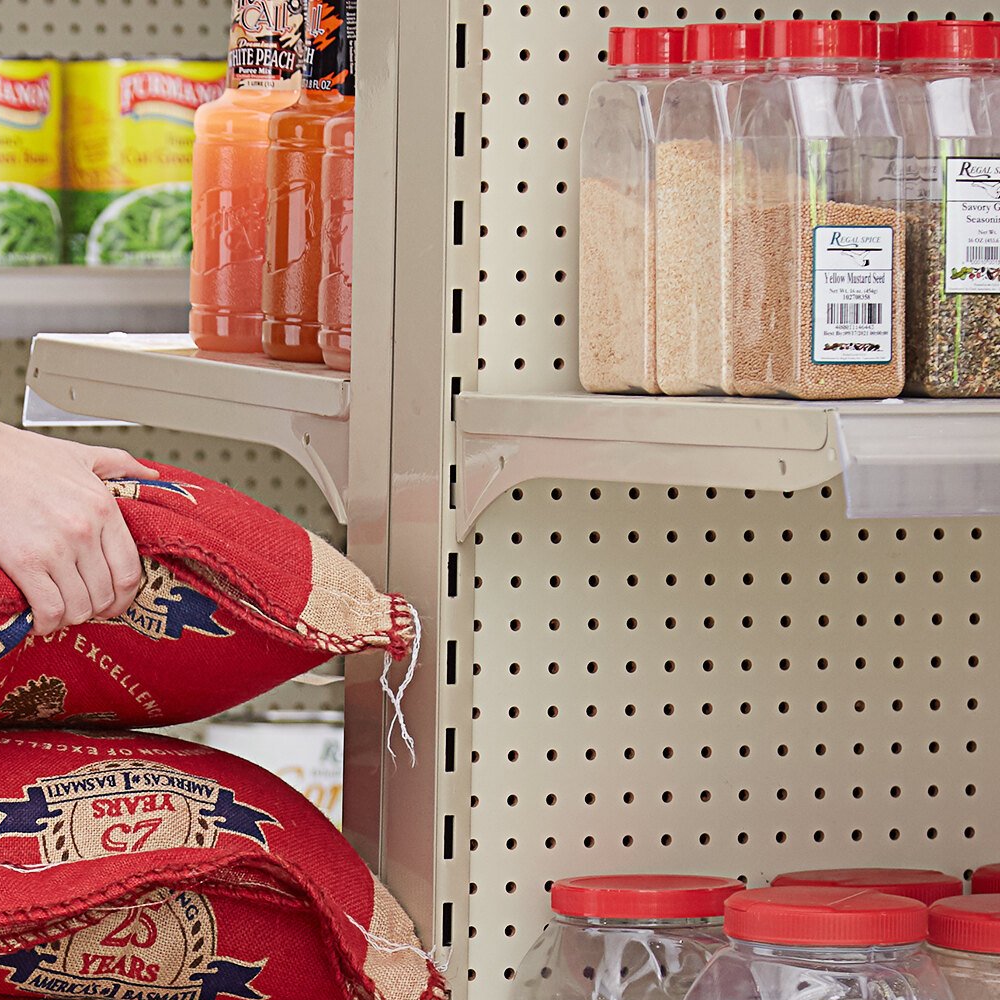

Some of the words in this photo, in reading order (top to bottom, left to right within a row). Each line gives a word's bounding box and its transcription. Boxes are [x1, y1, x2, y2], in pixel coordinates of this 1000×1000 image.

[255, 48, 296, 71] PEACH
[321, 81, 331, 90] OZ
[959, 161, 991, 179] REGAL
[962, 203, 991, 213] Savory
[830, 231, 859, 247] REGAL
[861, 235, 882, 243] SPICE
[824, 272, 845, 283] Yellow
[847, 272, 871, 283] Mustard
[873, 272, 885, 283] Seed
[73, 633, 164, 718] EXCELLENC
[47, 775, 116, 798] BASMATI
[122, 771, 142, 791] #1
[143, 773, 215, 797] AMERICA'S
[91, 793, 175, 818] YEARS
[101, 900, 158, 948] 25
[79, 953, 160, 983] YEARS
[28, 974, 99, 996] AMERICA'S
[100, 983, 122, 998] #1
